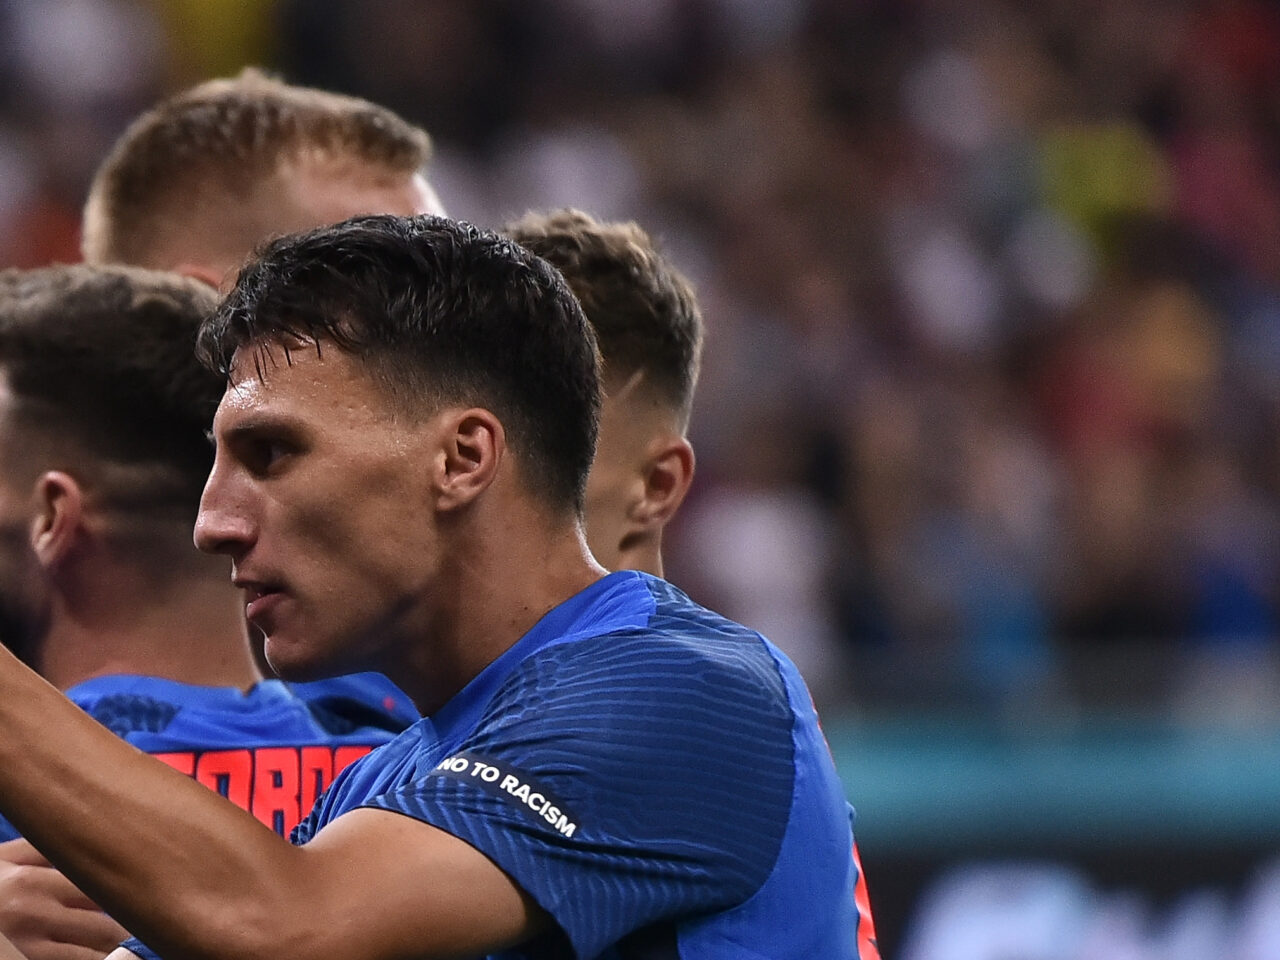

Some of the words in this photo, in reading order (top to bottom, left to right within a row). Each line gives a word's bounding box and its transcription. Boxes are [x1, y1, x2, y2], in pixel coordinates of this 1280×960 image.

[437, 757, 469, 773] NO
[470, 761, 500, 782] TO
[499, 774, 577, 838] RACISM
